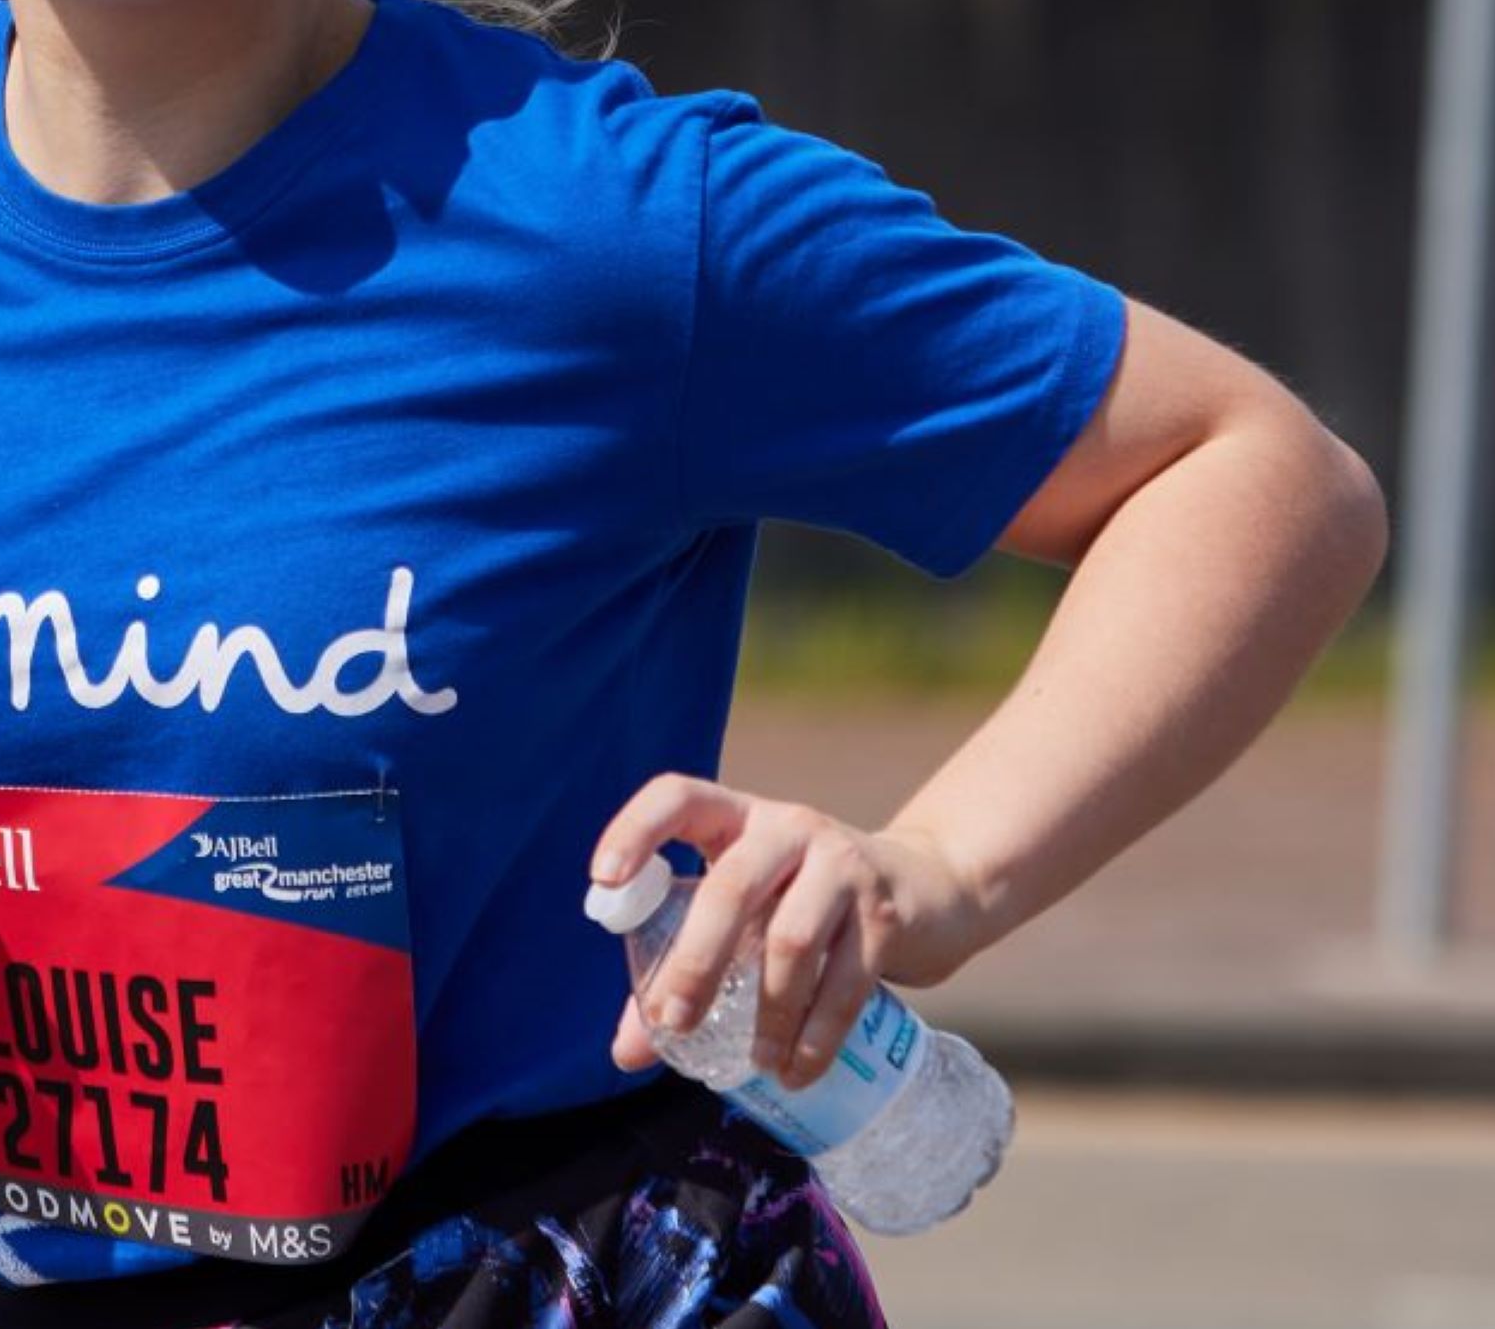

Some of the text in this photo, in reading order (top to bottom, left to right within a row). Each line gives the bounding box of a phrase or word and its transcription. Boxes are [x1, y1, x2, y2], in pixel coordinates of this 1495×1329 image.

[214, 861, 393, 892] great manchester
[210, 1225, 233, 1252] by
[250, 1223, 331, 1258] M&S
